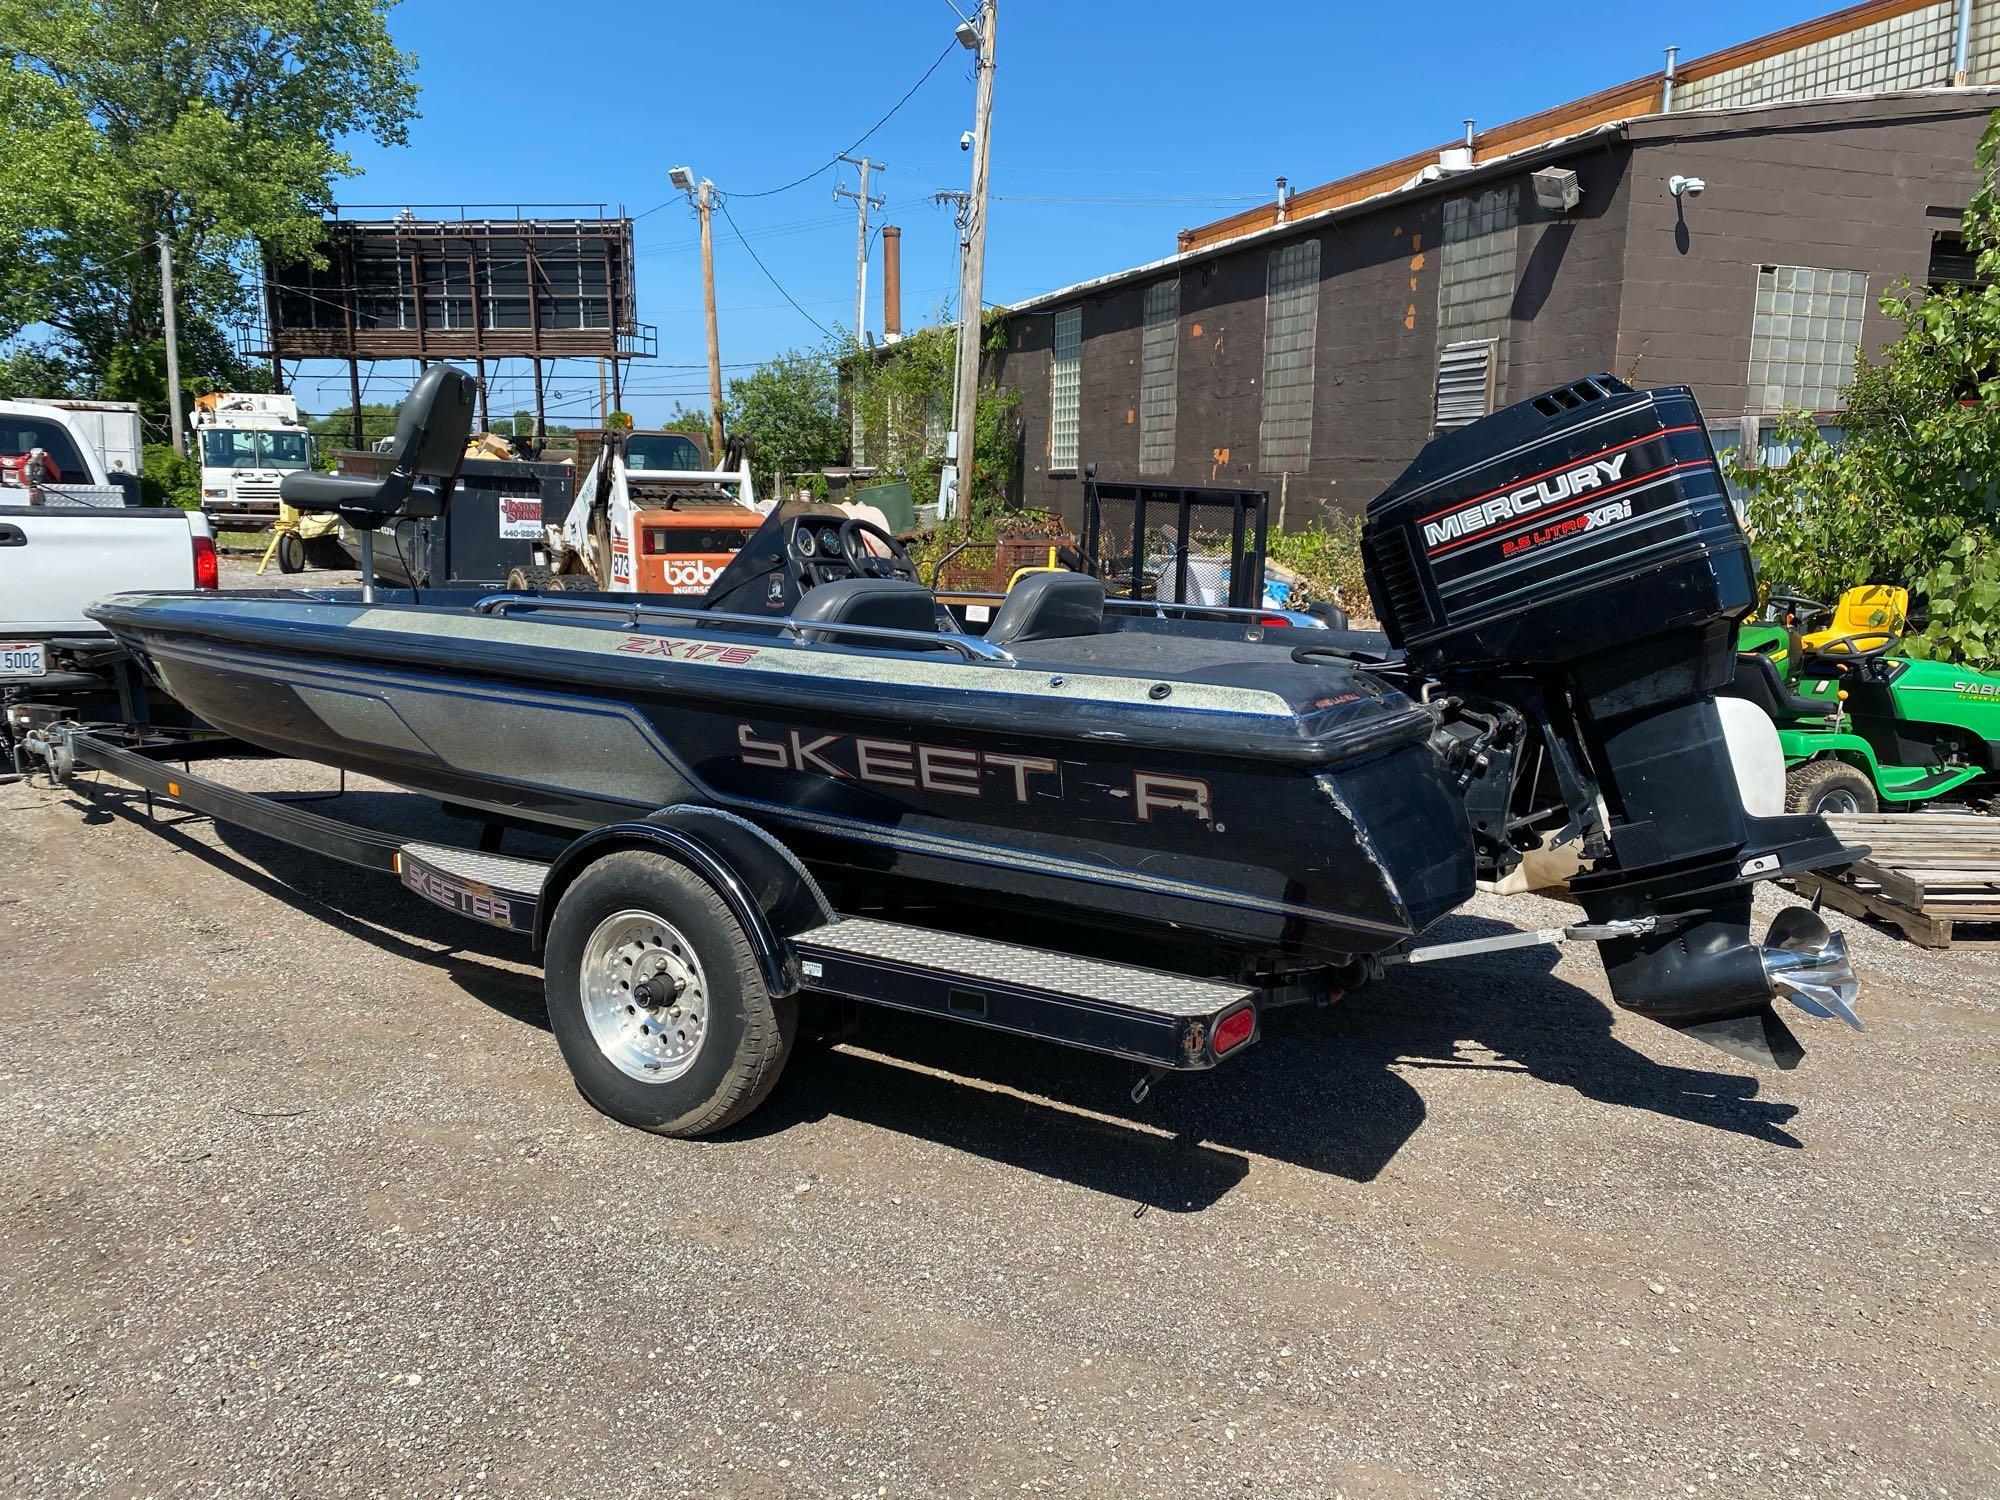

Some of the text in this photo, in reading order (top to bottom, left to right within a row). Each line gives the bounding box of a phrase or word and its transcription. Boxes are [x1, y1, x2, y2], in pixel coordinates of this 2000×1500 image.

[1424, 453, 1627, 546] MERCURY
[1502, 535, 1531, 555] 2.5
[1584, 500, 1633, 531] XRi
[613, 554, 629, 577] 873
[5, 653, 39, 668] 5002
[409, 863, 512, 926] SKEETER
